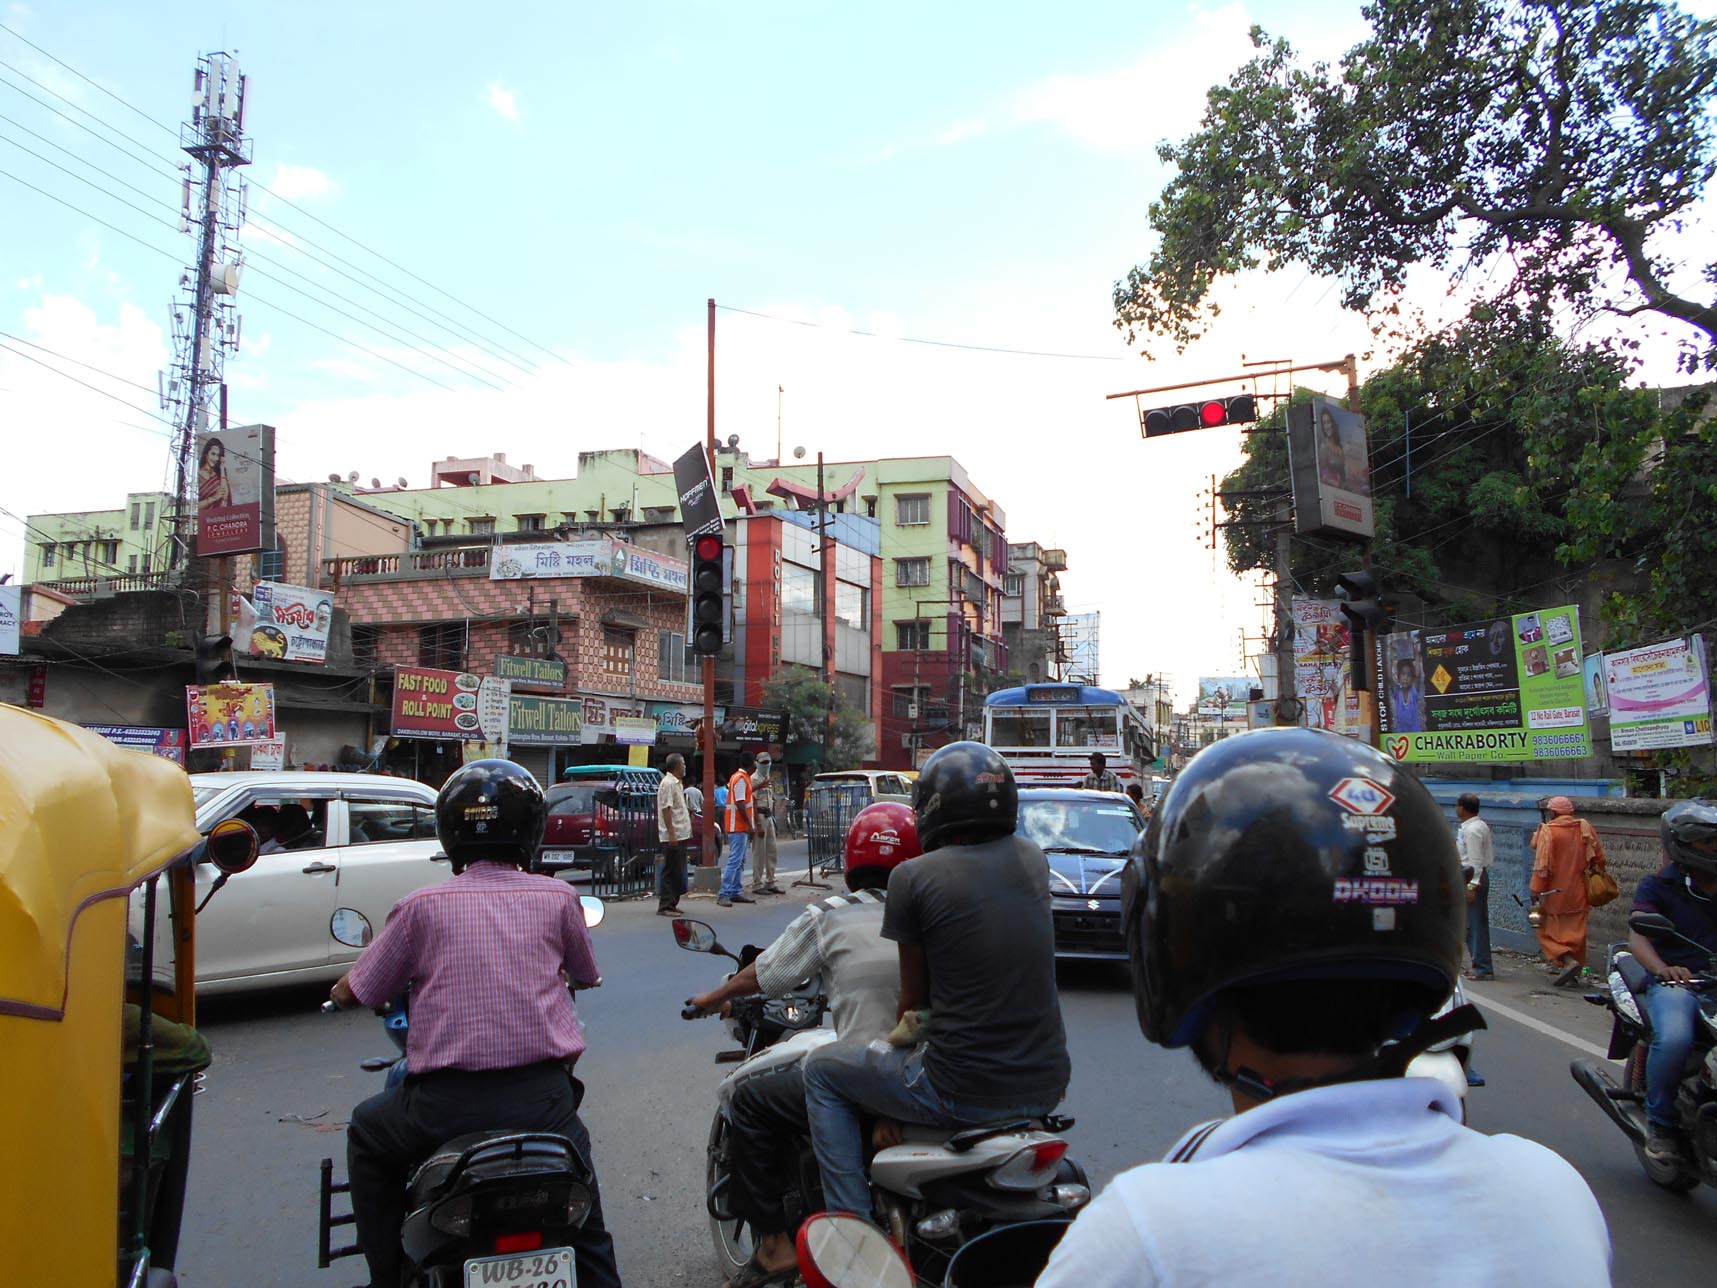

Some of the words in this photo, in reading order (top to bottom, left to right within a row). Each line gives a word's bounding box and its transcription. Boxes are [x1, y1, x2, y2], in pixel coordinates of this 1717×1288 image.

[219, 520, 248, 531] CHANDRA
[535, 551, 561, 569] মিষ্টি
[566, 554, 595, 568] মহল
[629, 554, 661, 580] মিষ্টি
[500, 658, 531, 677] Fitwell
[532, 662, 564, 680] Tailors
[398, 672, 422, 691] FAST
[423, 676, 449, 694] FOOD
[1377, 673, 1385, 699] CHILD
[402, 700, 425, 717] ROLL
[426, 702, 453, 719] POINT
[510, 700, 545, 730] Fitwell
[547, 703, 581, 732] Tailors
[1379, 701, 1388, 732] STOP
[1564, 708, 1580, 718] Barasat
[1414, 732, 1528, 751] CHAKRABORTY
[1532, 733, 1585, 746] 9836066661
[1436, 752, 1457, 760] Wall
[1459, 751, 1486, 761] Paper
[1490, 750, 1505, 760] Co.
[1533, 745, 1588, 758] 9836066663
[1340, 812, 1396, 832] Supreme
[1333, 878, 1420, 904] DHOOM
[482, 1255, 559, 1284] WB-26
